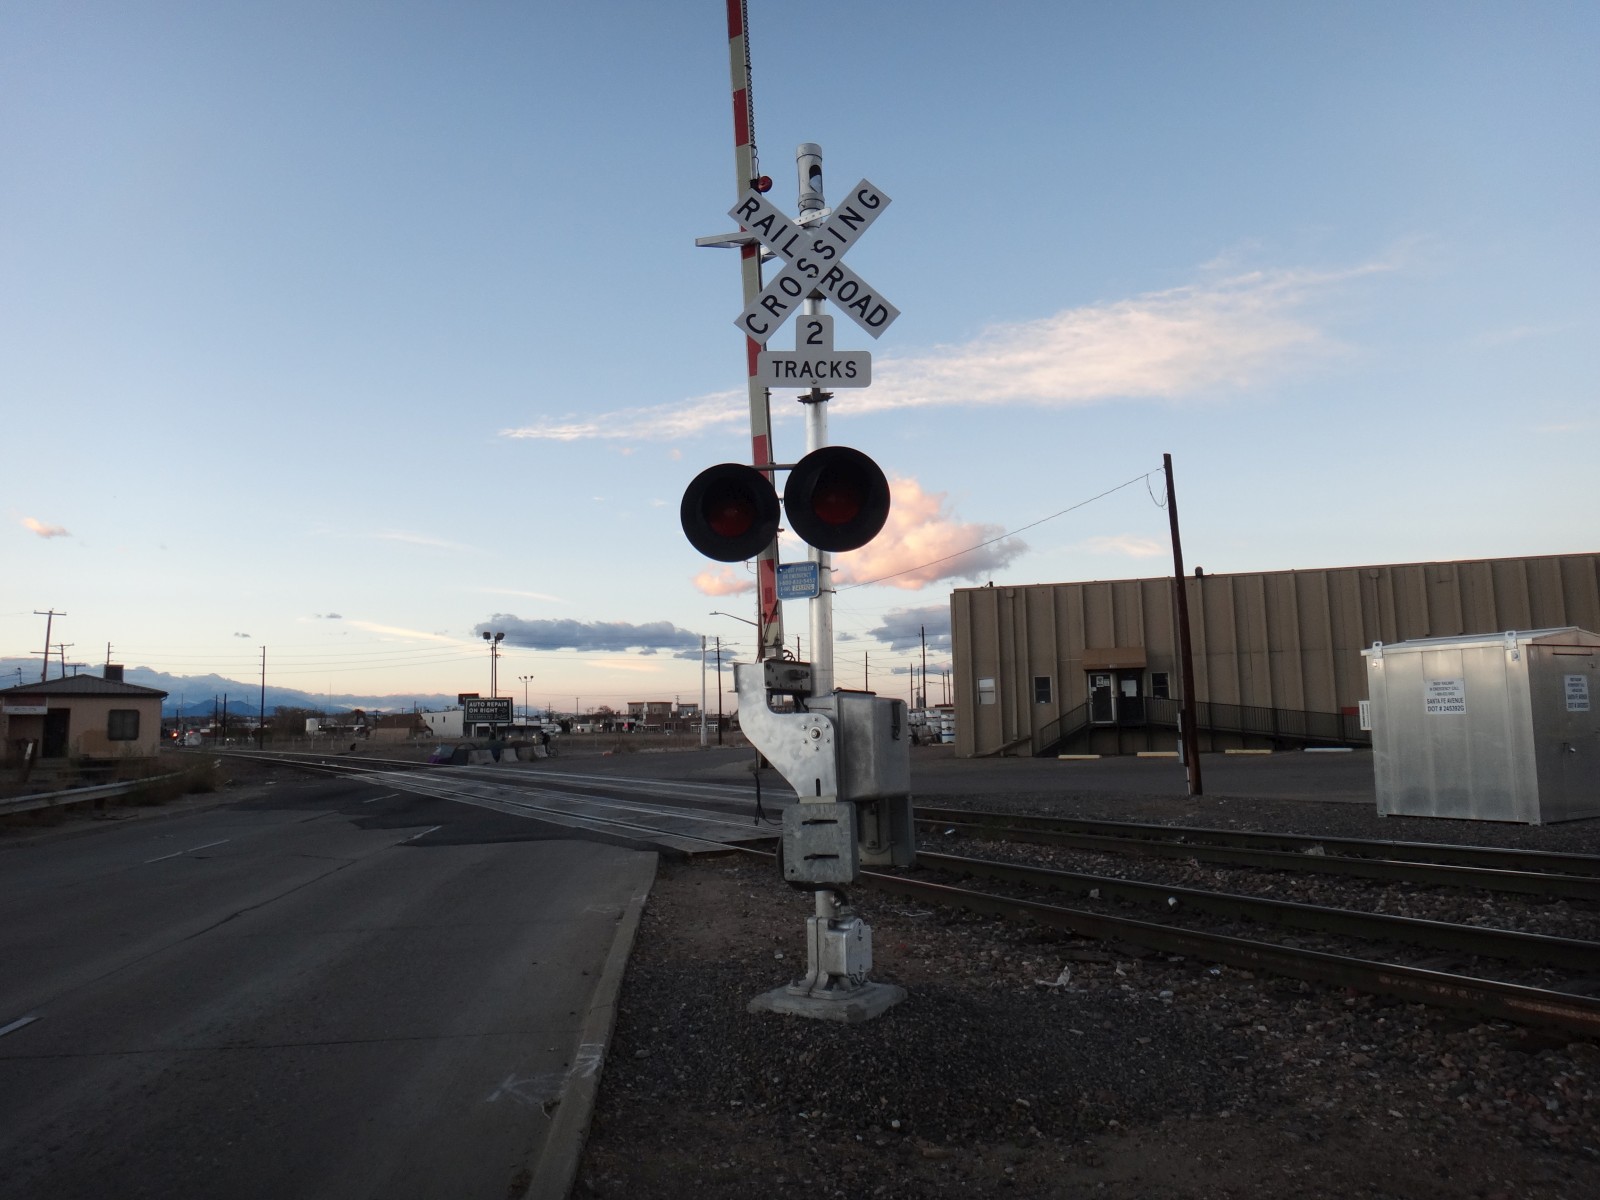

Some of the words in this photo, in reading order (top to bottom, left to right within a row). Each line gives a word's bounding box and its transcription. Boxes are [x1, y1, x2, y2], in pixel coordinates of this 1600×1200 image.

[745, 188, 881, 335] CROSSING
[806, 321, 823, 345] 2
[772, 360, 857, 378] TRACKS
